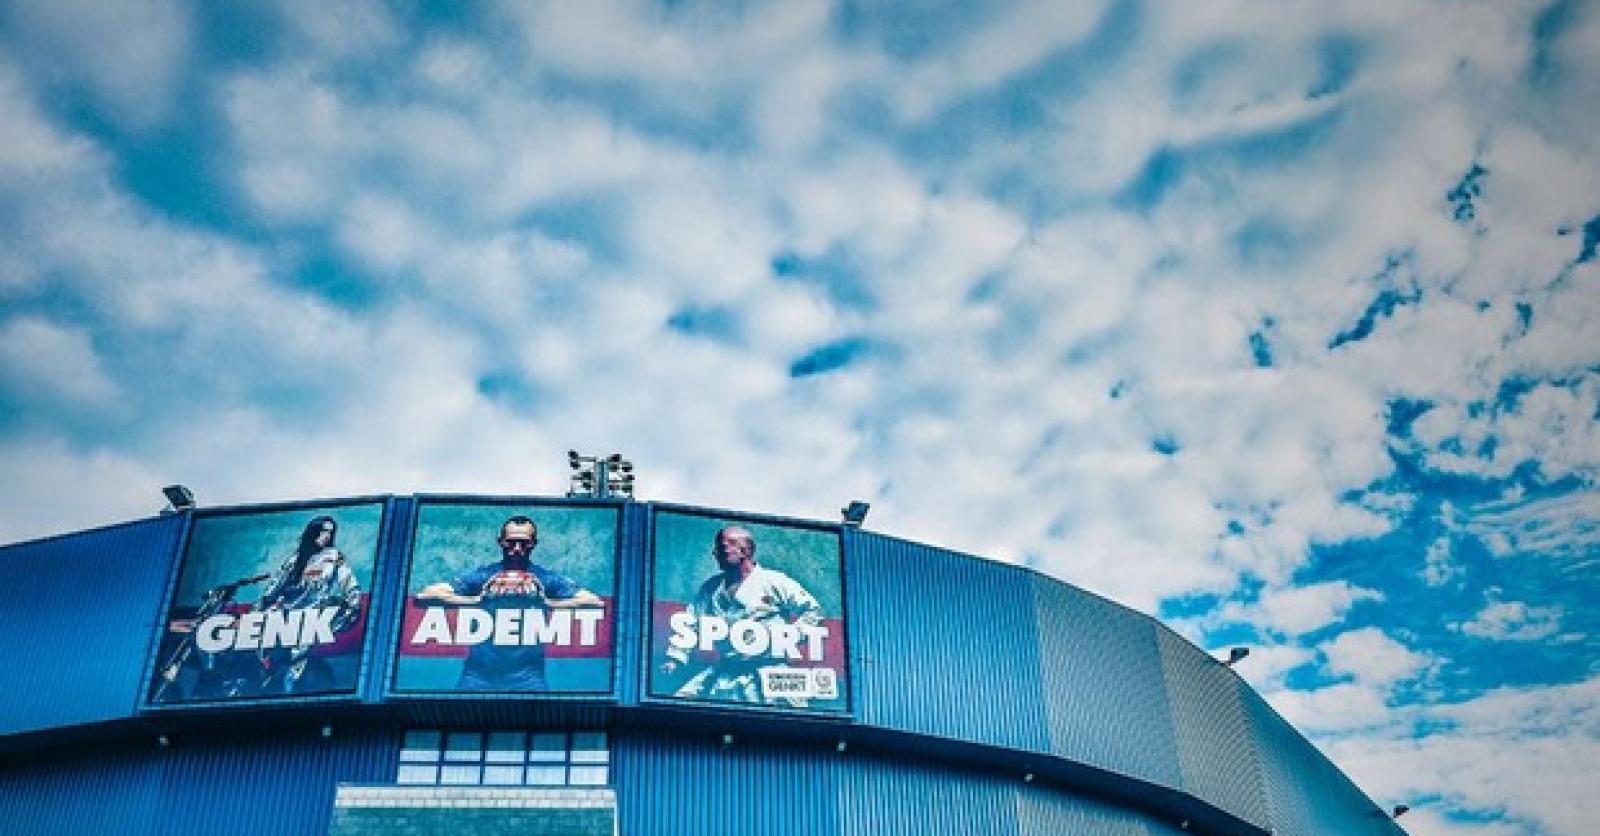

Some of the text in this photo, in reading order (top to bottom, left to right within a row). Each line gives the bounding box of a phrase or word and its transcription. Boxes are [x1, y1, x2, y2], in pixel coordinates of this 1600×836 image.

[196, 606, 340, 652] GENK
[410, 606, 605, 646] ADEMT
[668, 612, 829, 661] SPORT
